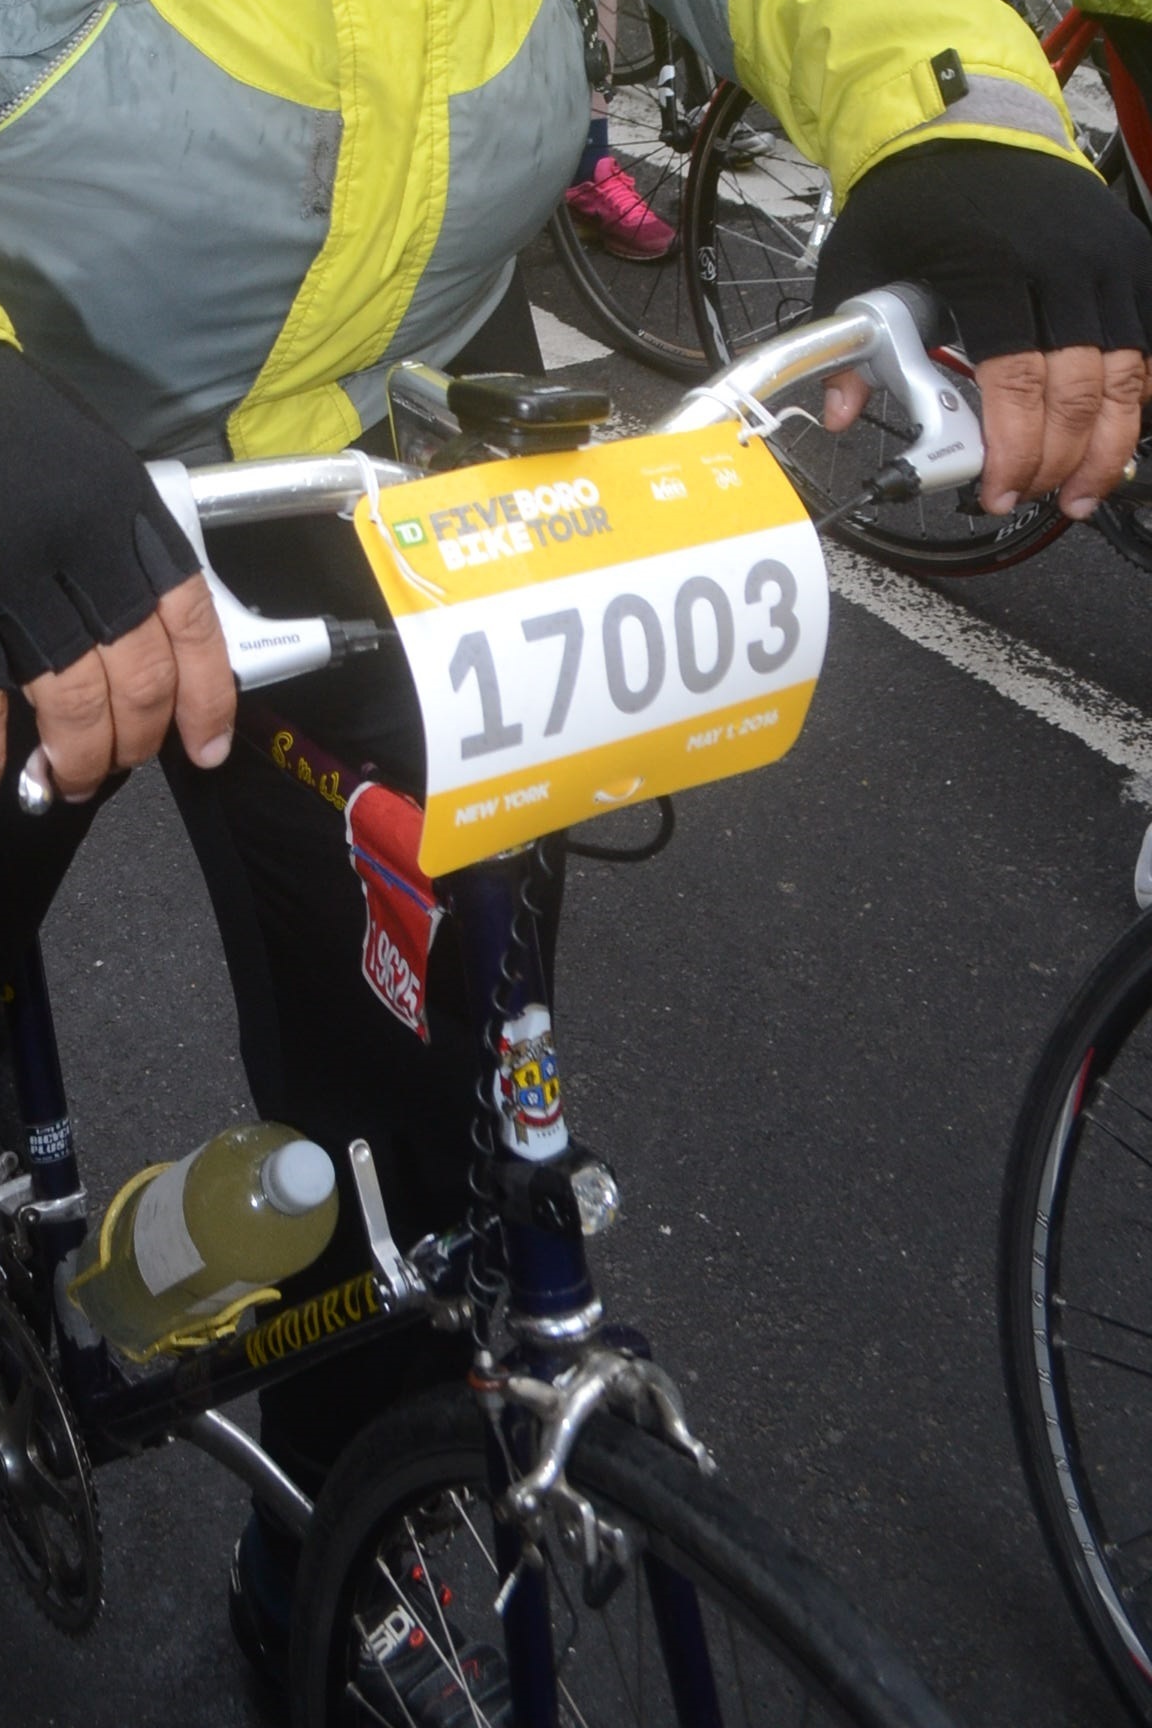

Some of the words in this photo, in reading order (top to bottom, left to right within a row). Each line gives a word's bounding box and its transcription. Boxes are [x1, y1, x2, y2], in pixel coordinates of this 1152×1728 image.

[397, 522, 424, 544] TD
[448, 558, 801, 761] 17003
[685, 725, 721, 753] MAY
[738, 709, 780, 735] 2016
[454, 798, 500, 827] NEW
[504, 781, 551, 812] YORK
